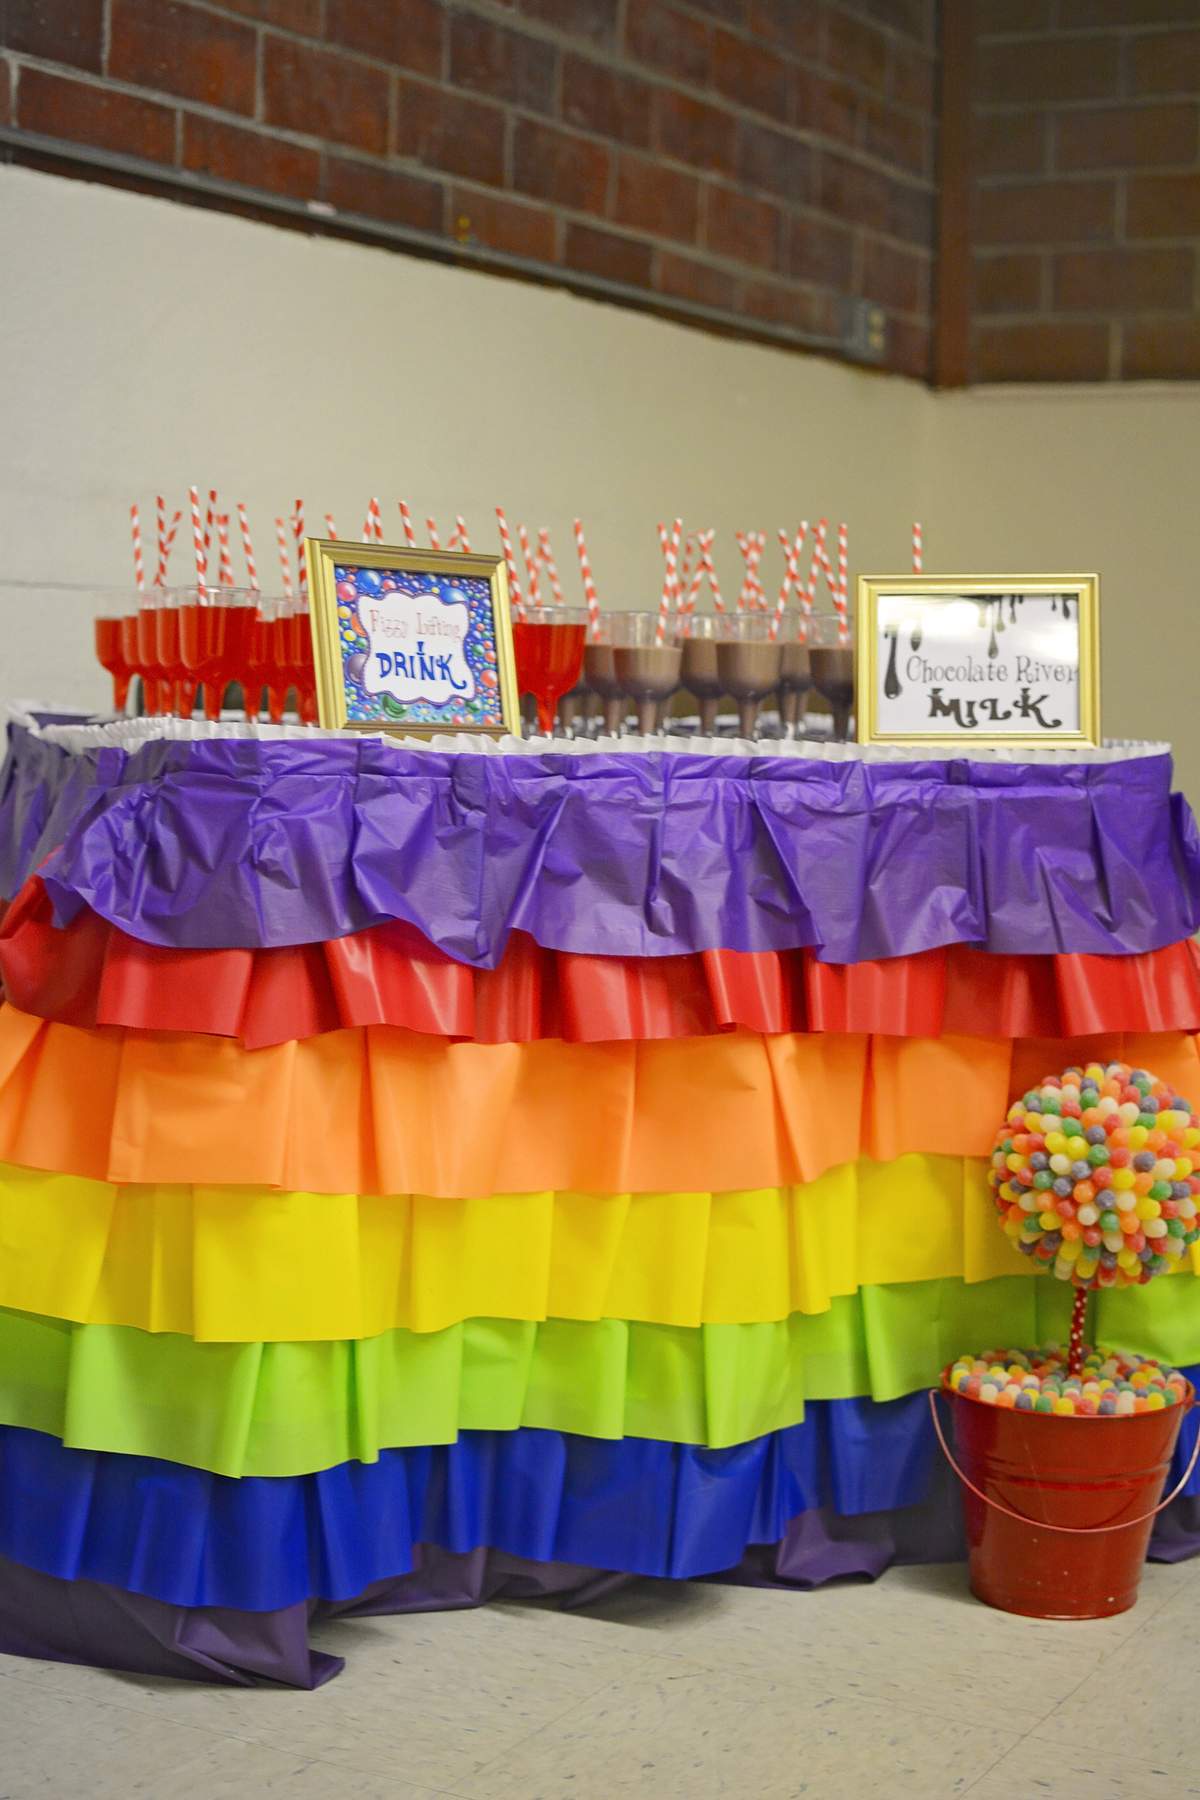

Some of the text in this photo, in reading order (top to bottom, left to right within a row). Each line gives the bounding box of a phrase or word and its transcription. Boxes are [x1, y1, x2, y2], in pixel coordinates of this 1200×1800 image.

[369, 609, 409, 638] Fizzy
[375, 641, 467, 690] DRINK
[906, 655, 1079, 684] Chocolate River
[928, 687, 1063, 729] MILK
